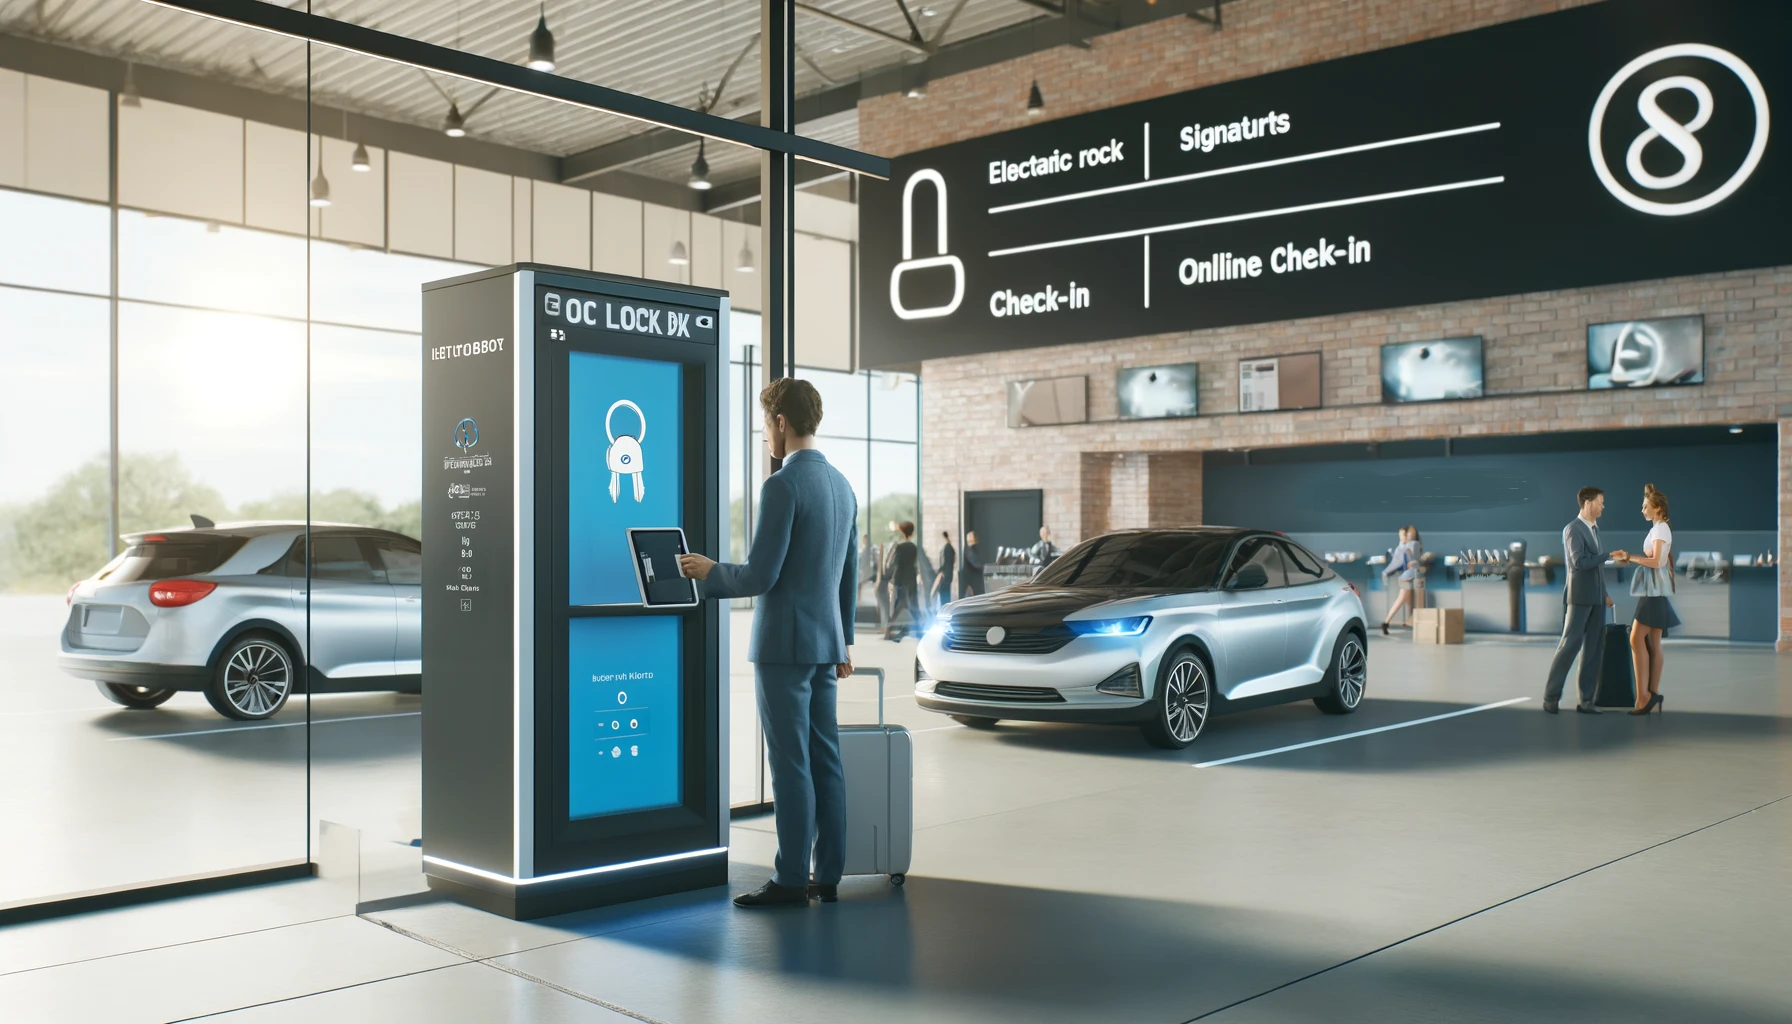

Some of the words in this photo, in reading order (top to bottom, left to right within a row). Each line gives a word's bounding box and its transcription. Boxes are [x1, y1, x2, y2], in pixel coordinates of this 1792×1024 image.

[1079, 138, 1124, 169] rock
[1178, 252, 1263, 286] Onlline
[1270, 235, 1372, 274] Chek-in
[989, 281, 1090, 318] Check-in
[606, 302, 663, 335] LOCK
